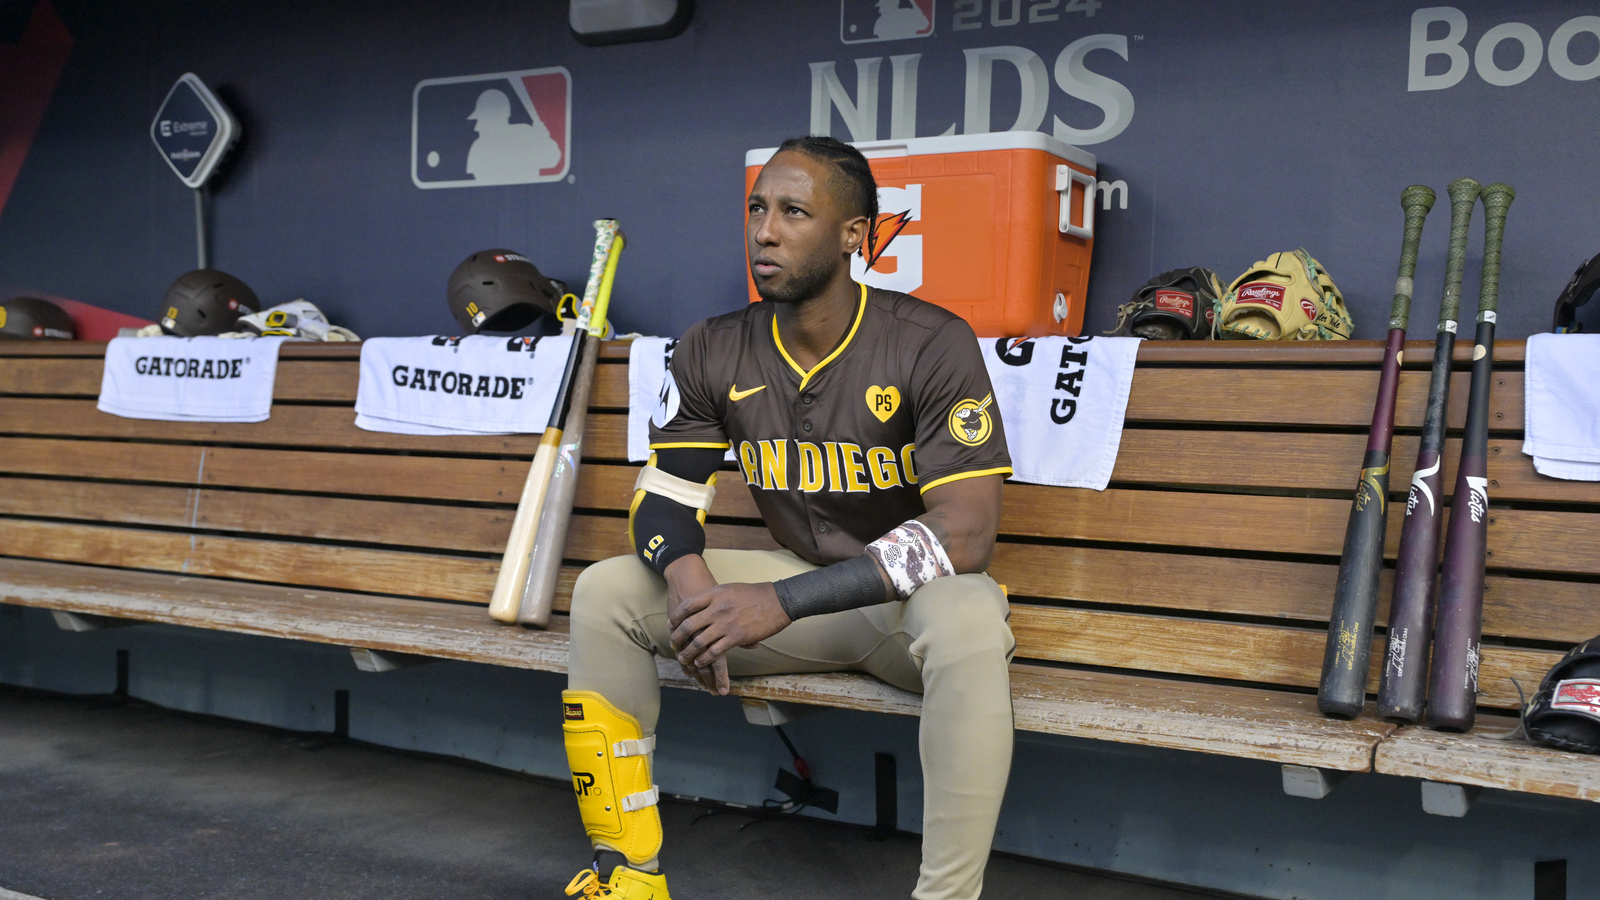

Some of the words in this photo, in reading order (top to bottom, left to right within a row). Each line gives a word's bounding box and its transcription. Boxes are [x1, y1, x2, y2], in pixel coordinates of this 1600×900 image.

[808, 33, 1135, 146] NLDS
[1240, 287, 1281, 299] Rawlings
[466, 302, 479, 317] 10
[135, 355, 244, 380] GATORADE
[392, 365, 526, 401] GATORADE
[875, 393, 893, 413] PS
[729, 438, 790, 492] AN
[643, 534, 665, 563] 10
